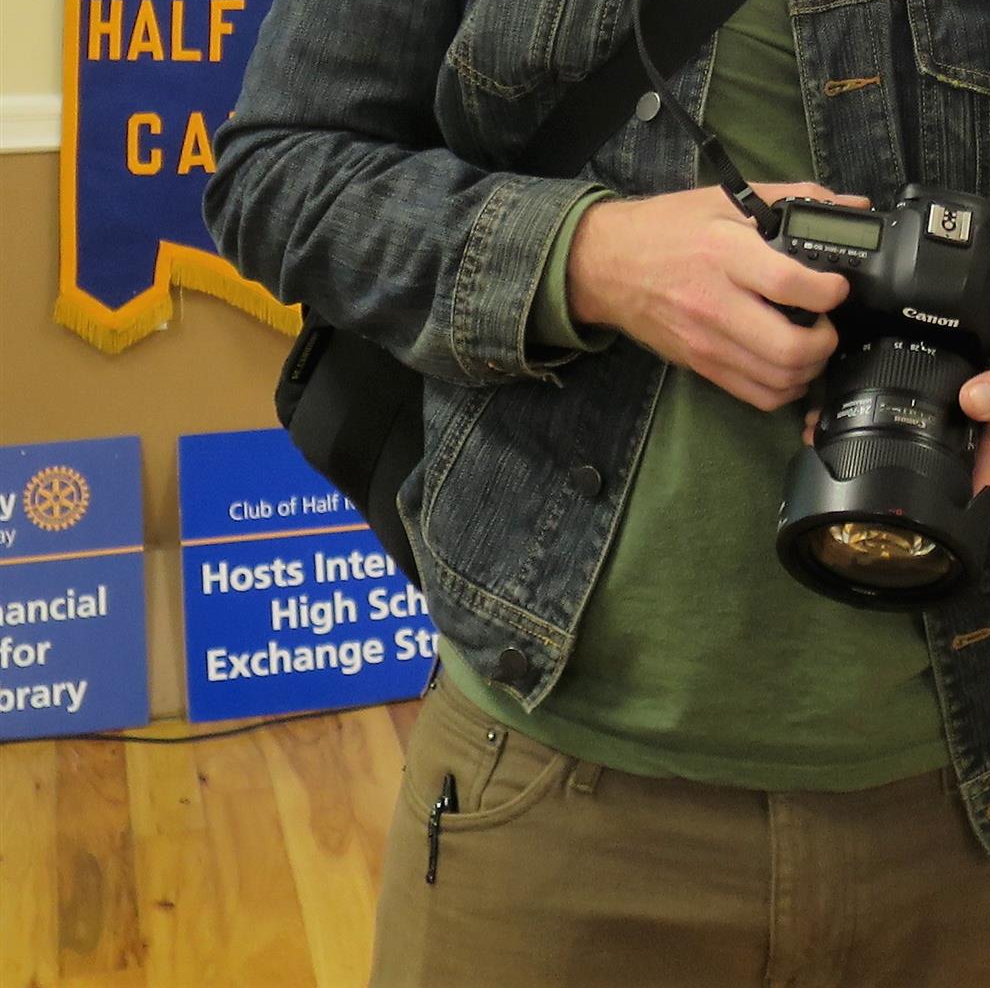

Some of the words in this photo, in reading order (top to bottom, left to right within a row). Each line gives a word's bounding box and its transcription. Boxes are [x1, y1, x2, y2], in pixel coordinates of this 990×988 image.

[127, 111, 216, 176] CA
[902, 307, 960, 328] Canon
[229, 500, 273, 521] Club
[277, 497, 297, 516] of
[302, 494, 340, 514] Half
[201, 556, 304, 594] Hosts
[0, 583, 107, 627] ancial
[271, 591, 358, 636] High
[368, 583, 428, 620] Sch
[0, 636, 51, 669] for
[206, 637, 385, 681] Exchange
